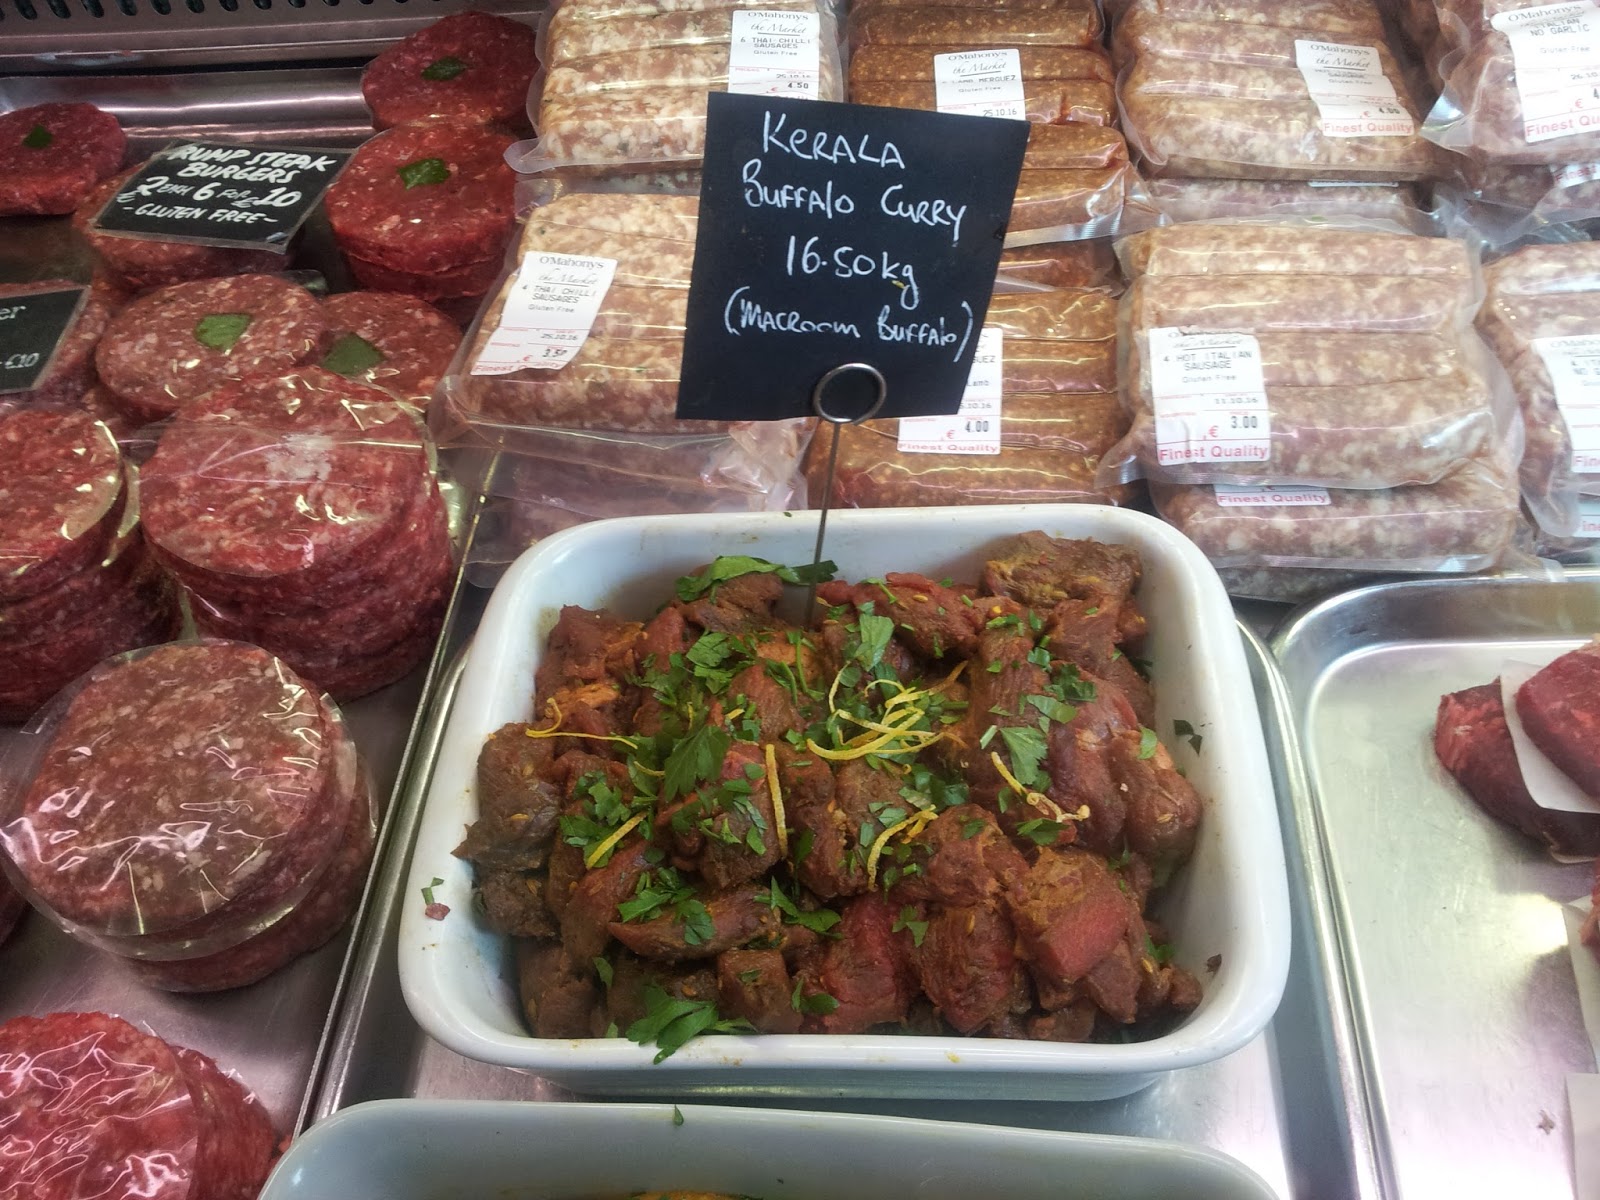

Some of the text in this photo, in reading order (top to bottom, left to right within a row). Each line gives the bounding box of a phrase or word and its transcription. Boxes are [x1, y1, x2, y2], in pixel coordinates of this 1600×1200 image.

[1550, 24, 1590, 35] GARLIC
[1324, 122, 1412, 134] Finest Quality
[1526, 119, 1575, 137] Finest
[245, 151, 337, 172] STEAK
[177, 161, 300, 184] BURGERS
[534, 285, 556, 293] THAI
[562, 288, 596, 297] CHILLI
[532, 292, 580, 304] SAUSAGES
[527, 304, 575, 313] Gluten Free
[1176, 353, 1196, 362] HOT
[1205, 351, 1252, 360] ITALIAN
[1184, 360, 1232, 371] SAUSAGE
[965, 420, 989, 433] 4.00
[1230, 415, 1258, 429] 3.00
[898, 443, 999, 453] Finest Quality
[1159, 444, 1268, 461] Finest Quality
[1218, 493, 1327, 504] Finest Quality
